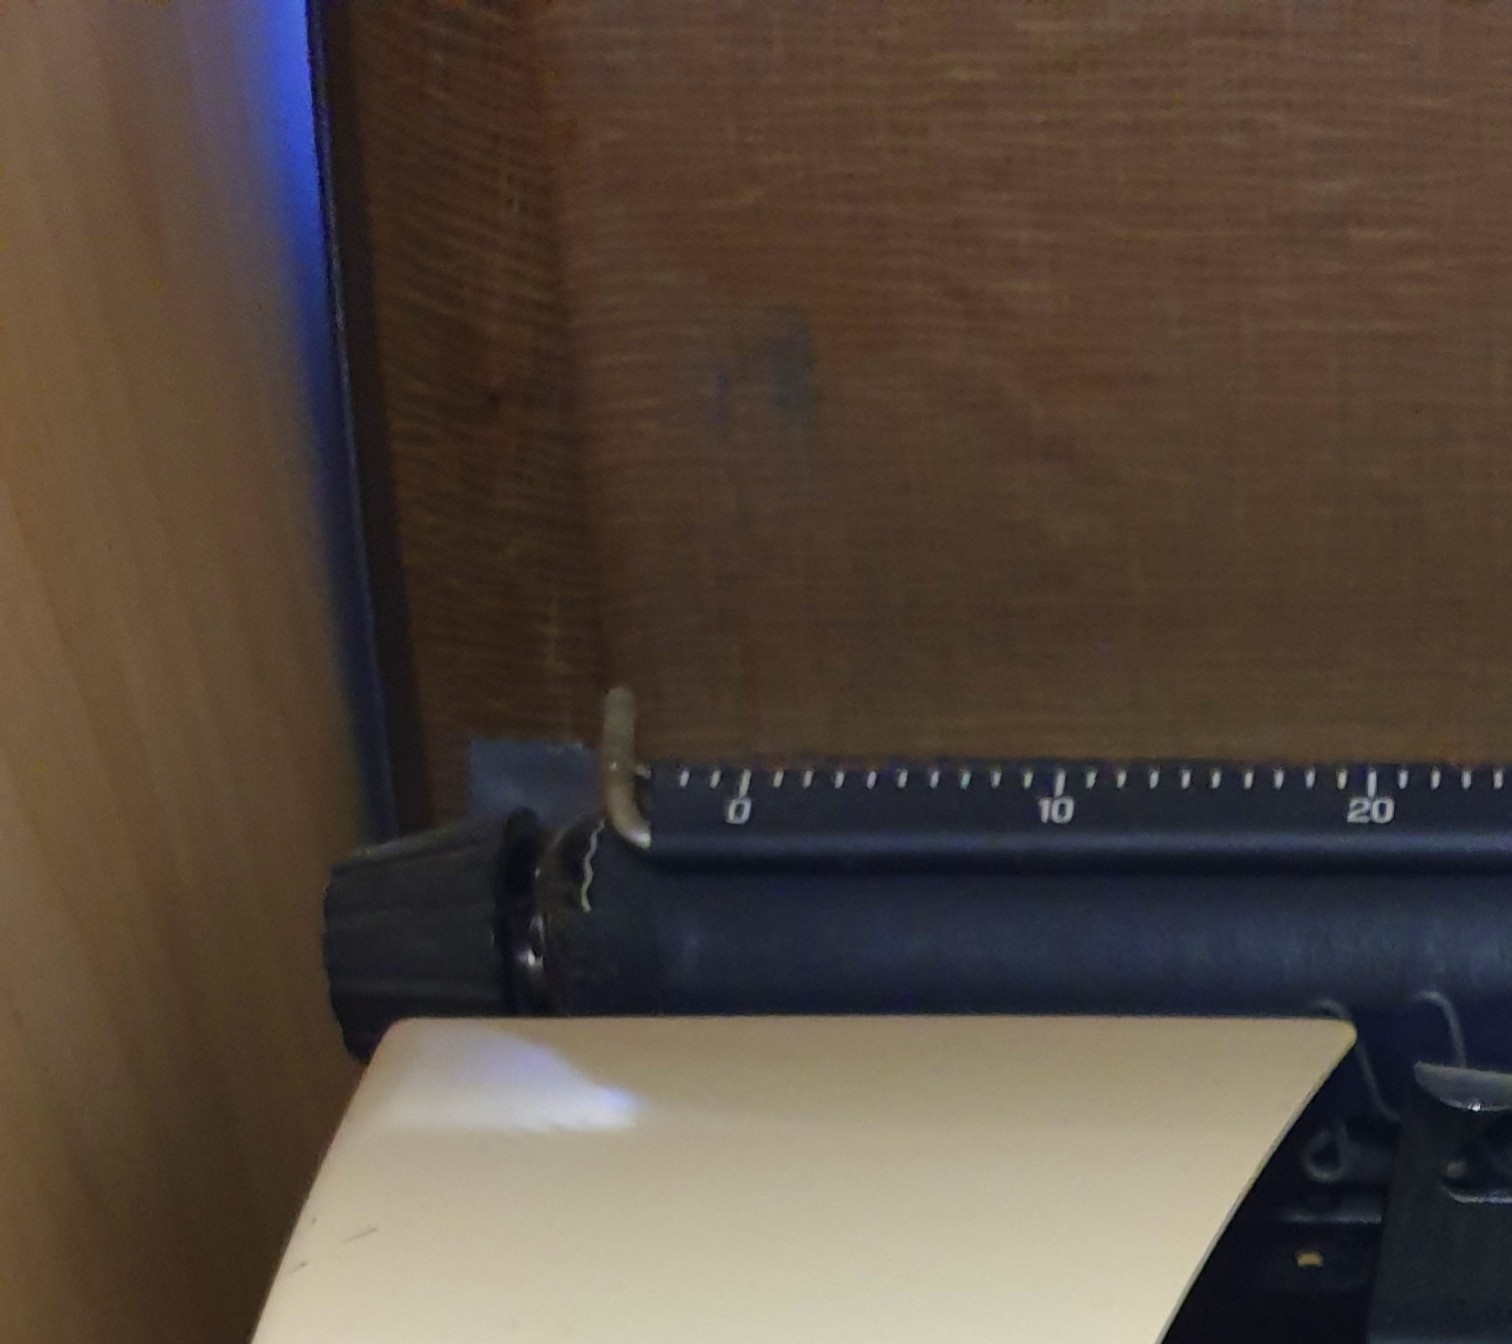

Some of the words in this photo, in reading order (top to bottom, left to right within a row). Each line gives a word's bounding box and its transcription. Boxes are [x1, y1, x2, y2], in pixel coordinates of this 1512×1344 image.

[727, 799, 752, 824] 0
[1038, 797, 1075, 823] 10
[1347, 797, 1395, 824] 20
